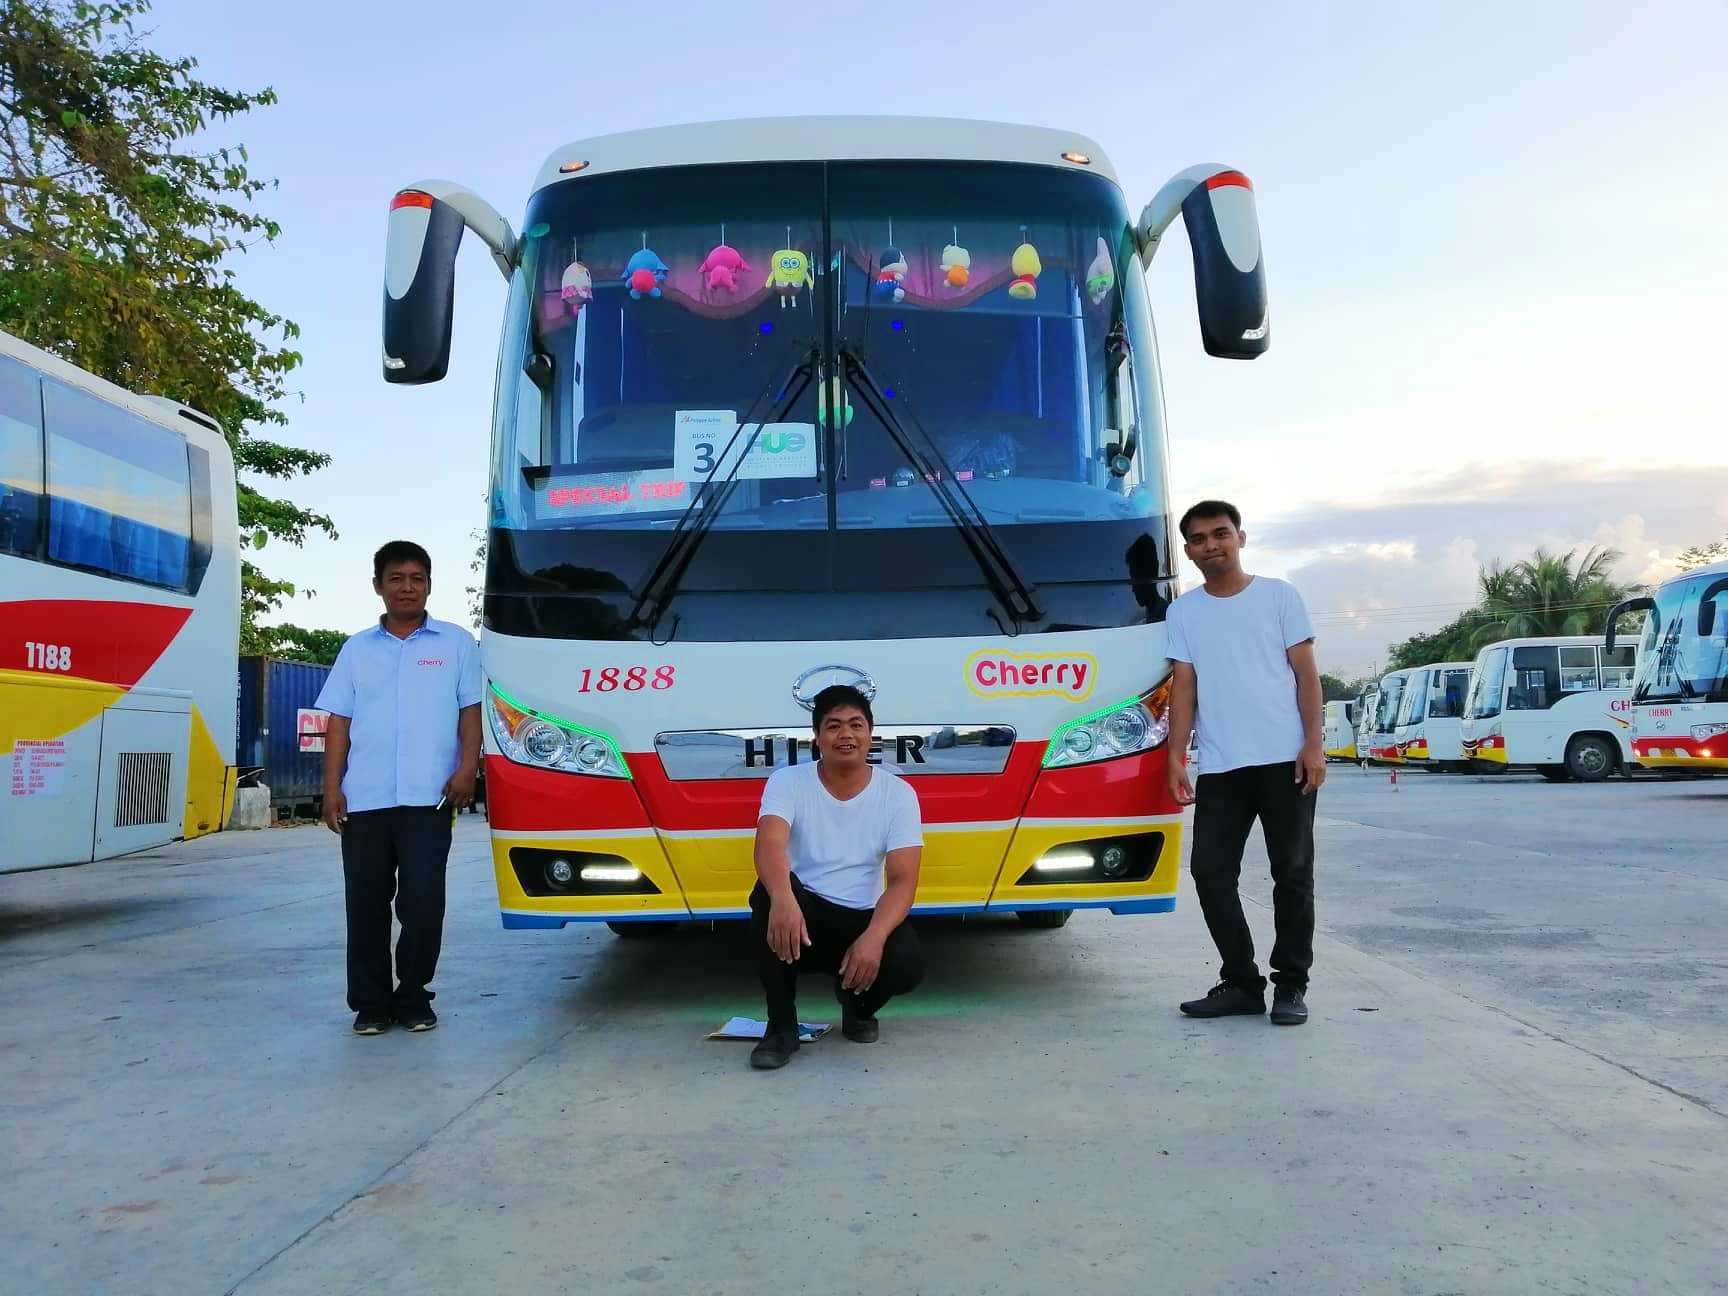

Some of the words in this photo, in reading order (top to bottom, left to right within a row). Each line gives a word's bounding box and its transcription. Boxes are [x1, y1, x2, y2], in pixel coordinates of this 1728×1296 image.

[693, 443, 715, 473] 3
[549, 485, 631, 507] SPECIAL
[25, 641, 72, 671] 1188
[417, 659, 443, 667] Cherry
[578, 664, 676, 693] 1888
[975, 660, 1087, 690] Cherry
[1648, 708, 1672, 717] CHERRY
